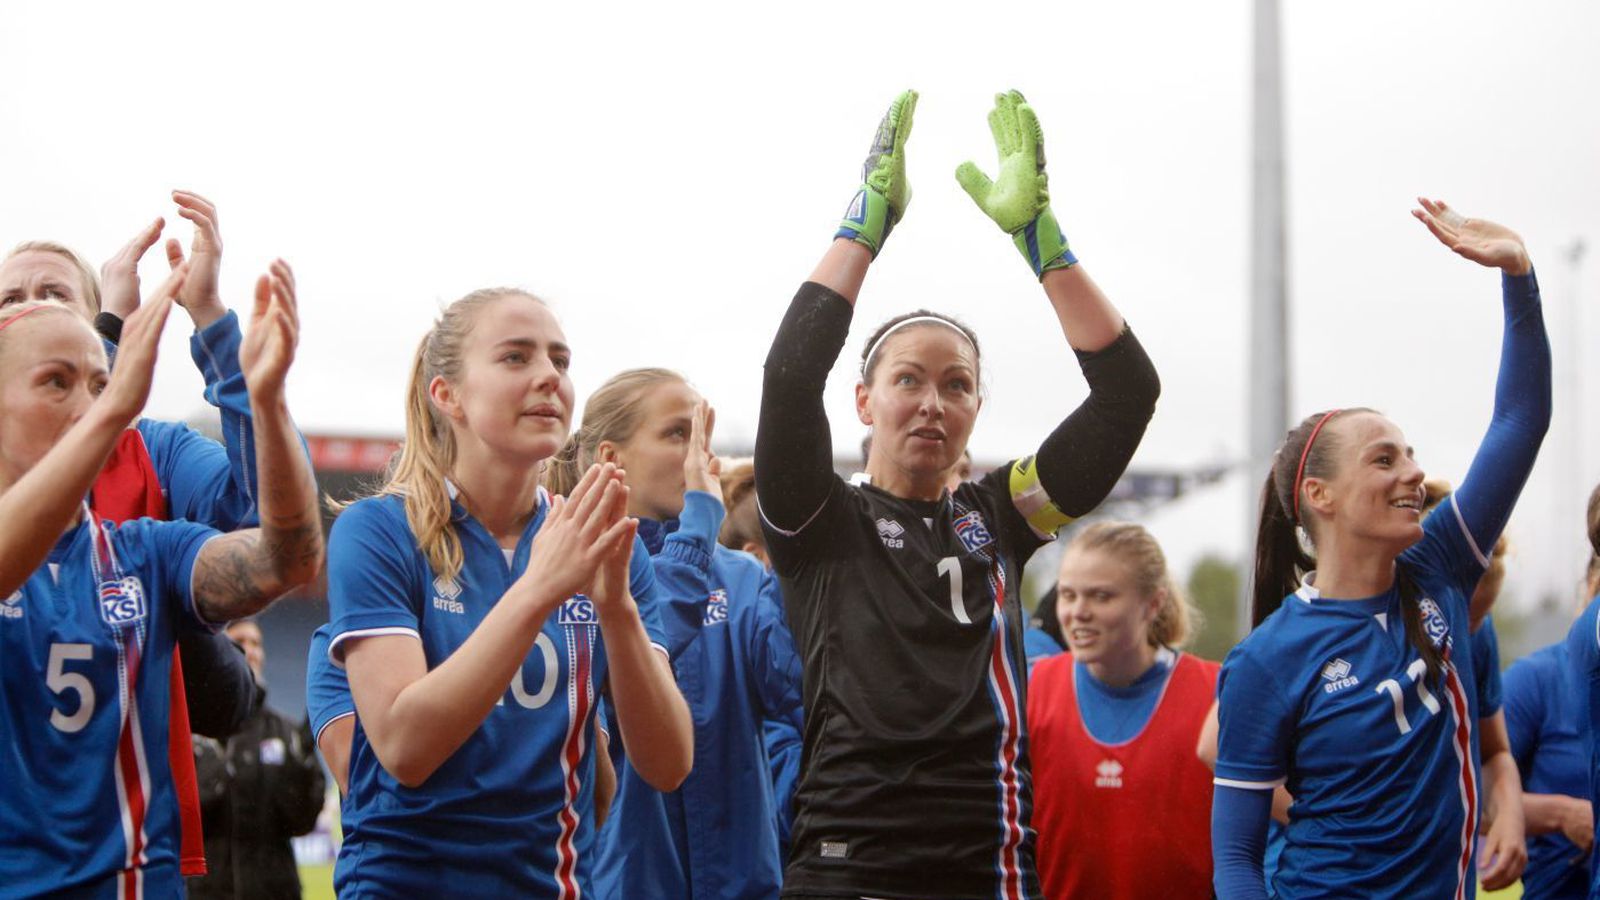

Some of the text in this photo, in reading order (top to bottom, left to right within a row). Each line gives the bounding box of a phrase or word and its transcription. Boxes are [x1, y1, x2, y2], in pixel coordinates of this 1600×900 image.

[881, 537, 904, 549] rea
[963, 526, 991, 551] KS
[433, 596, 465, 614] errea
[936, 556, 972, 624] 1
[46, 642, 95, 734] 5
[495, 631, 559, 710] 0
[1324, 675, 1360, 694] errea
[1375, 658, 1440, 735] 11
